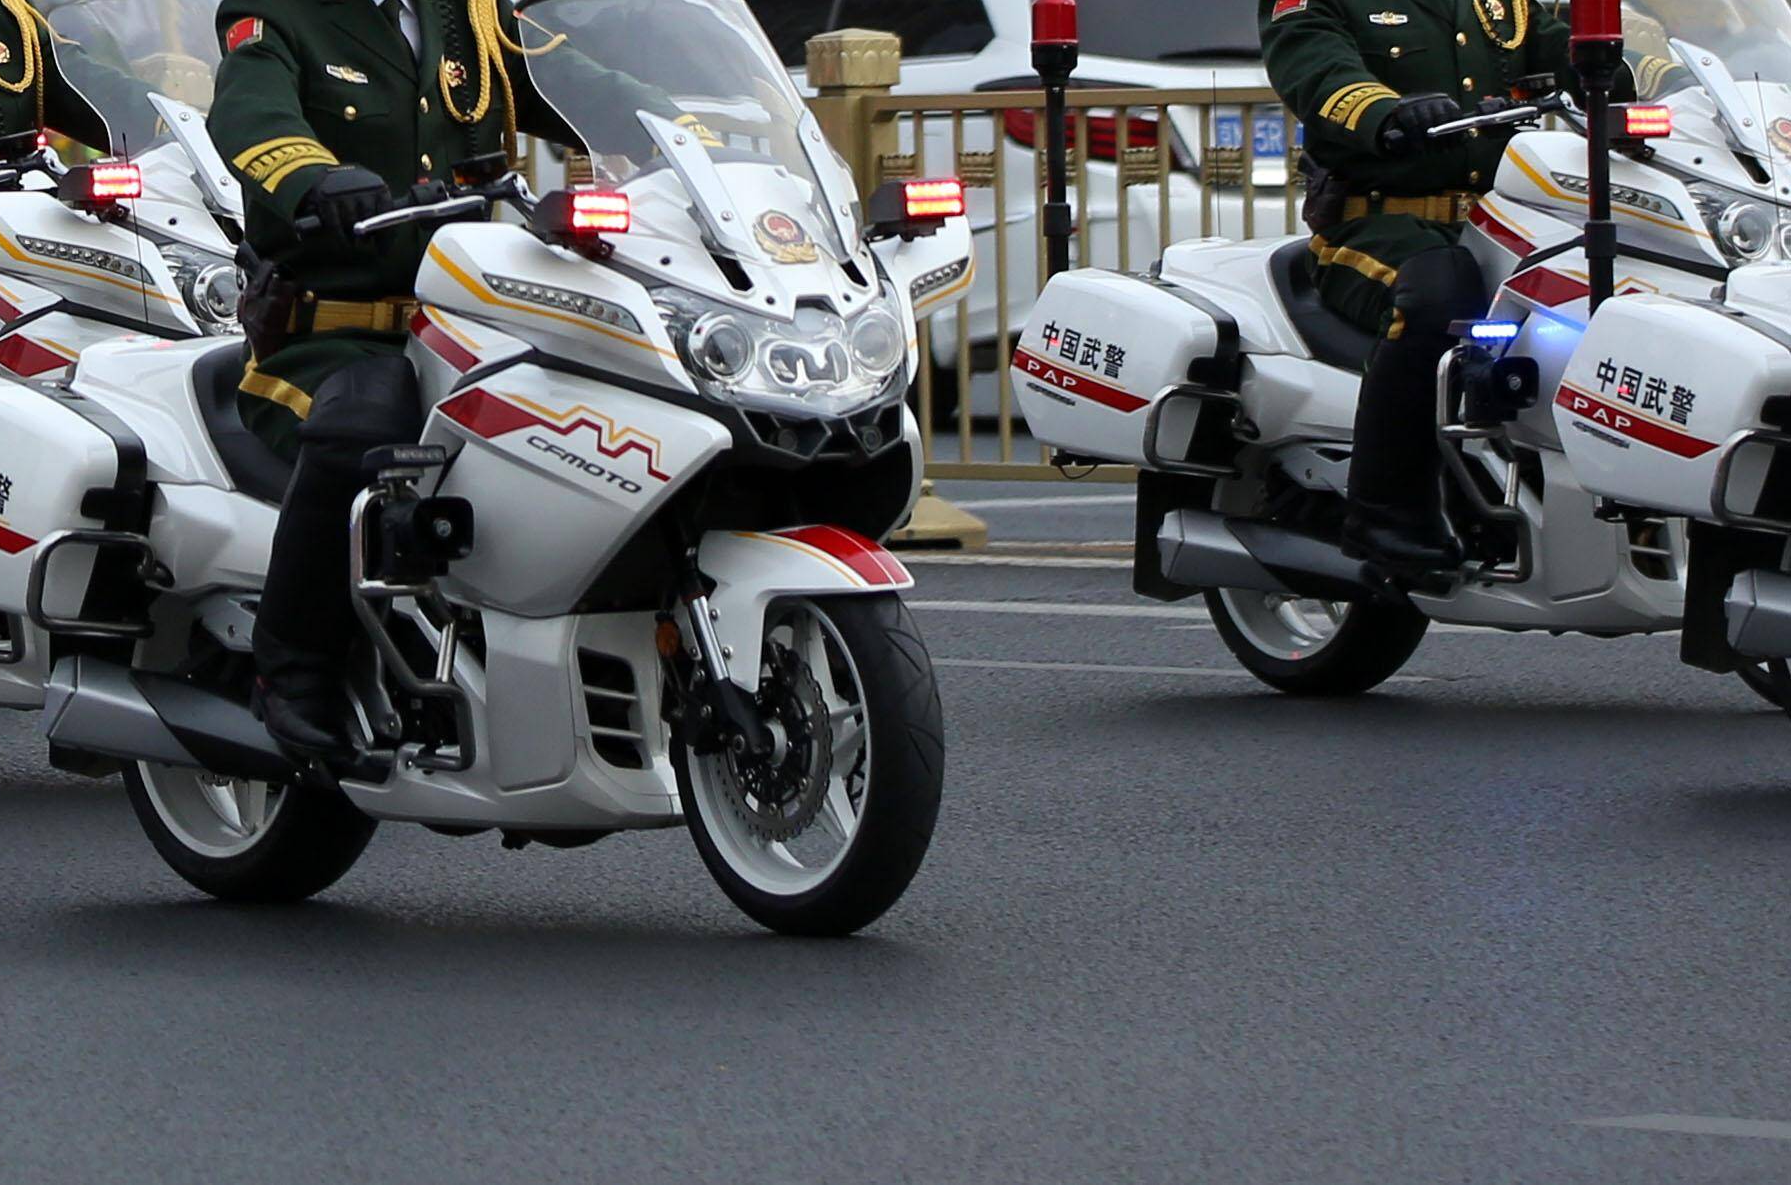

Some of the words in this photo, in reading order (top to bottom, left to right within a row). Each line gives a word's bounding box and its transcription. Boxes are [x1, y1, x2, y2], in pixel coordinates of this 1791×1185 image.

[1027, 359, 1077, 387] PAP
[1042, 320, 1126, 378] 中国武警
[1573, 397, 1632, 428] PAP
[1596, 357, 1696, 426] 中国武警
[526, 435, 642, 494] CFMOTO
